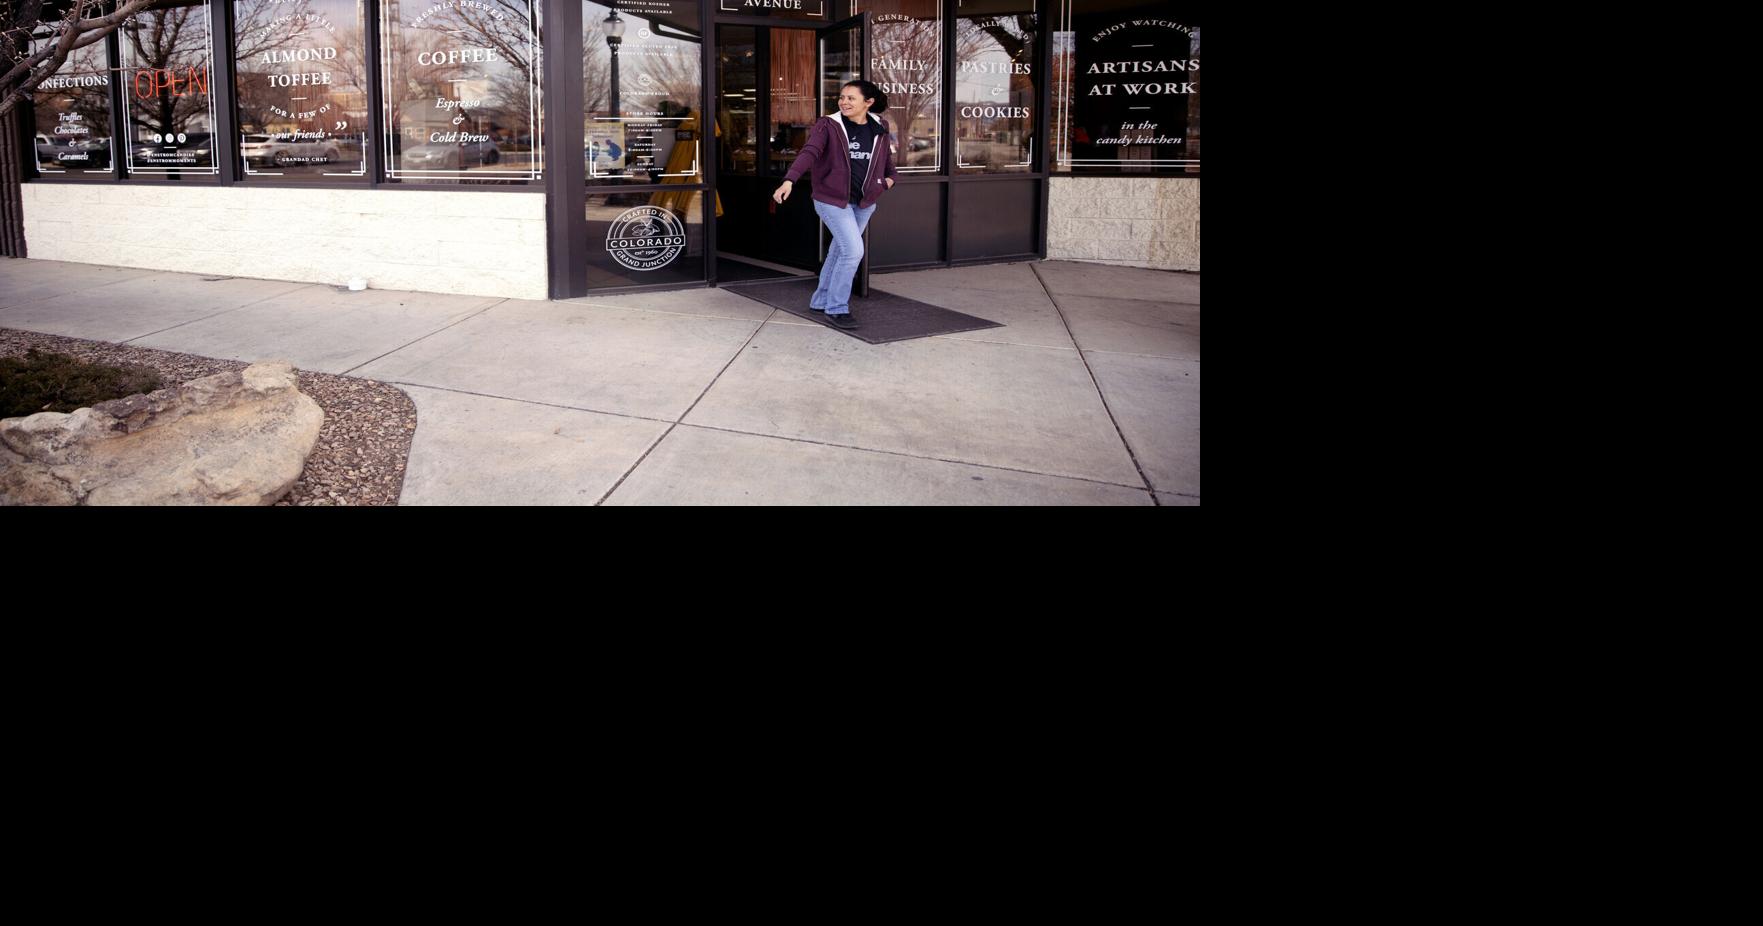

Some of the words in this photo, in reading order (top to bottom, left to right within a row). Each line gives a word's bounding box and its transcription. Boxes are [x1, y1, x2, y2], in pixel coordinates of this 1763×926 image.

[460, 0, 504, 21] BREWED
[744, 0, 802, 9] AVENUE
[260, 14, 292, 39] MAKING
[306, 13, 336, 34] LITTLE
[1092, 22, 1127, 42] ENJOY
[1132, 19, 1195, 38] WATCHING
[261, 47, 337, 64] ALMOND
[418, 48, 498, 65] COFFEE
[871, 58, 926, 71] FAMILY
[961, 60, 1031, 74] PASTRIES
[1087, 59, 1200, 74] ARTISANS
[37, 75, 109, 89] ONFECTIONS
[135, 65, 207, 99] OPEN
[268, 72, 332, 87] TOFFEE
[877, 82, 934, 94] SINESS
[1088, 84, 1116, 95] AT
[1122, 82, 1197, 95] WORK
[270, 105, 287, 117] FOR
[298, 110, 317, 119] FEW
[320, 103, 331, 113] OF
[435, 98, 480, 111] Espresso
[58, 112, 82, 123] Truffles
[453, 113, 465, 125] &
[961, 106, 1030, 119] COOKIES
[54, 124, 88, 134] Chocolates
[1121, 121, 1134, 130] in
[1138, 120, 1158, 130] the
[291, 128, 325, 142] friends
[430, 132, 457, 143] Cold
[460, 132, 489, 143] Brew
[1096, 135, 1133, 146] candy
[1135, 134, 1182, 144] kitchen
[68, 138, 77, 147] &
[58, 152, 89, 161] Caramels
[622, 209, 657, 222] CRAFTED
[610, 237, 682, 248] COLORADO
[616, 250, 640, 267] GRAND
[641, 247, 677, 268] JUNCTION
